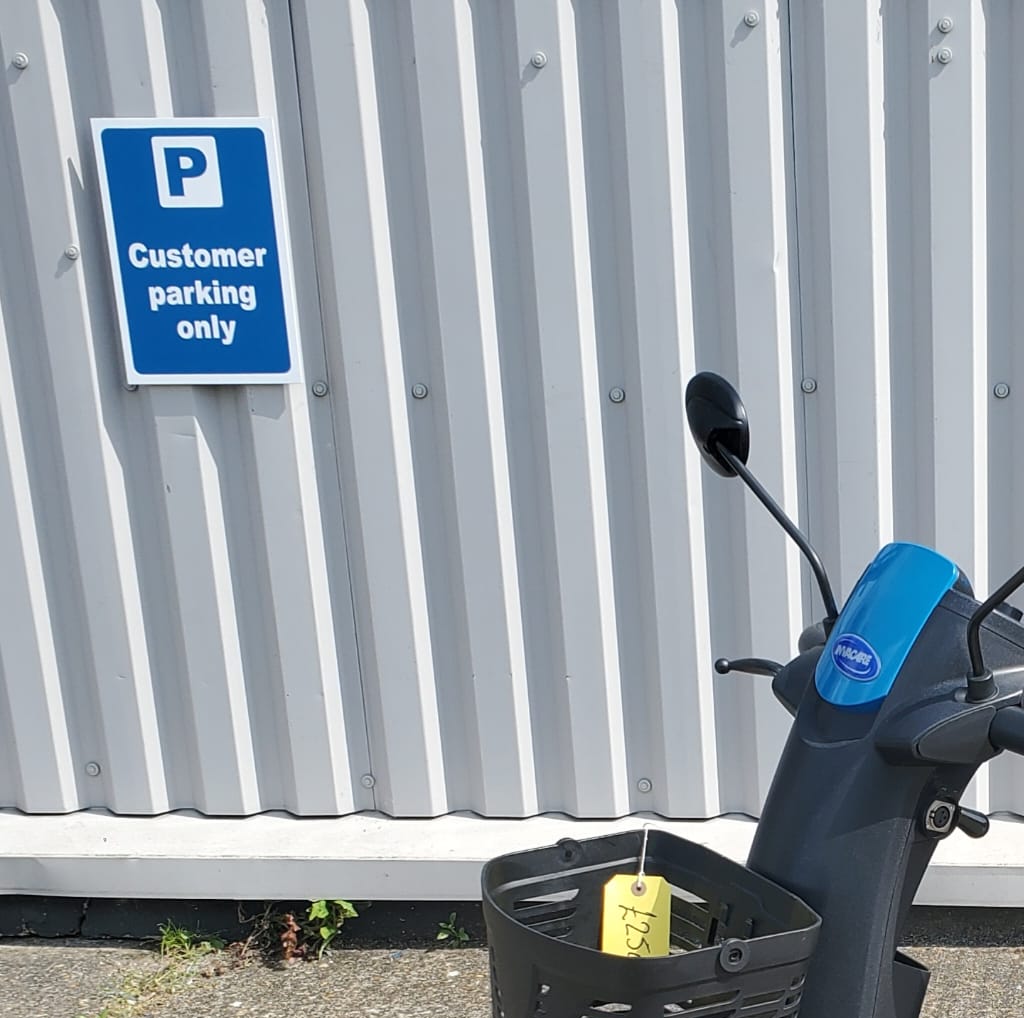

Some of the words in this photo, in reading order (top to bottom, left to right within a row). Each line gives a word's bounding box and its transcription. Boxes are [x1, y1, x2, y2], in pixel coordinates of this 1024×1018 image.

[163, 146, 208, 197] P
[128, 242, 267, 268] Customer
[148, 279, 257, 311] parking
[176, 314, 236, 345] only
